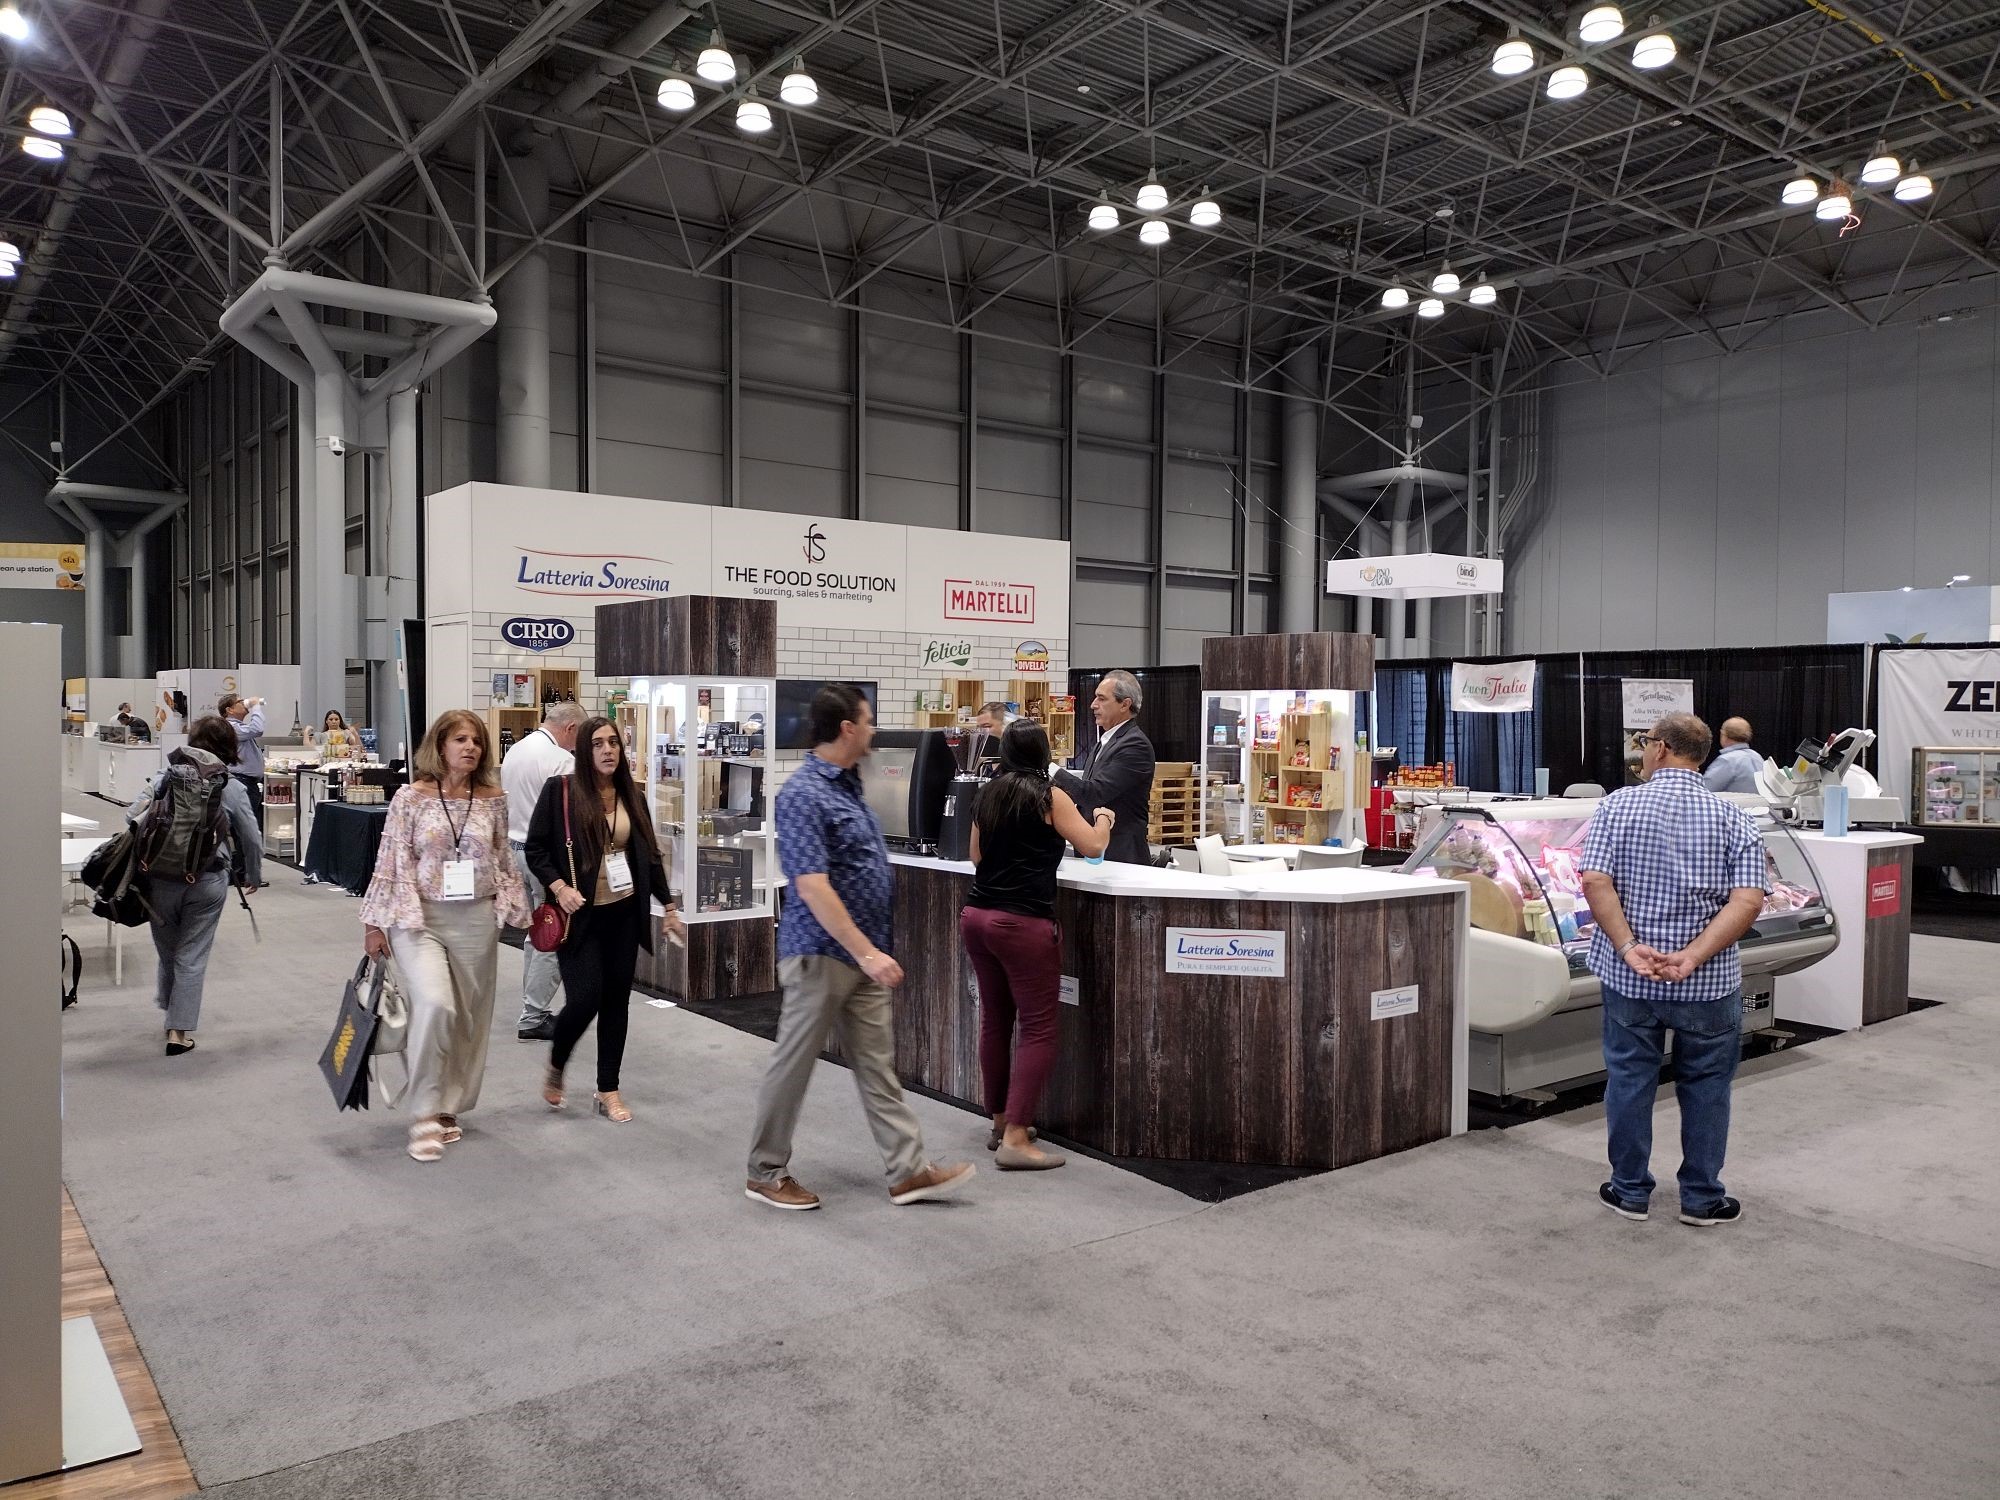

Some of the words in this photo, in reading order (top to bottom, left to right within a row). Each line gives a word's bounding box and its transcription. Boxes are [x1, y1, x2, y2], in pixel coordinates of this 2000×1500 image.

[28, 565, 54, 573] station
[517, 556, 594, 588] Latteria
[598, 562, 670, 592] Soresina
[724, 566, 758, 583] THE
[764, 569, 812, 587] FOOD
[817, 573, 896, 592] SOLUTION
[1459, 564, 1475, 578] bindi
[753, 586, 794, 598] sourcing,
[797, 589, 819, 598] sales
[821, 590, 827, 598] &
[830, 592, 873, 603] marketing
[951, 589, 1028, 614] MARTELLI
[507, 622, 569, 640] CIRIO
[923, 640, 971, 668] felicia
[1018, 660, 1045, 671] DIVELLA
[1944, 680, 2000, 712] ZE
[1177, 937, 1224, 955] Latteria
[1226, 939, 1274, 957] Soresina
